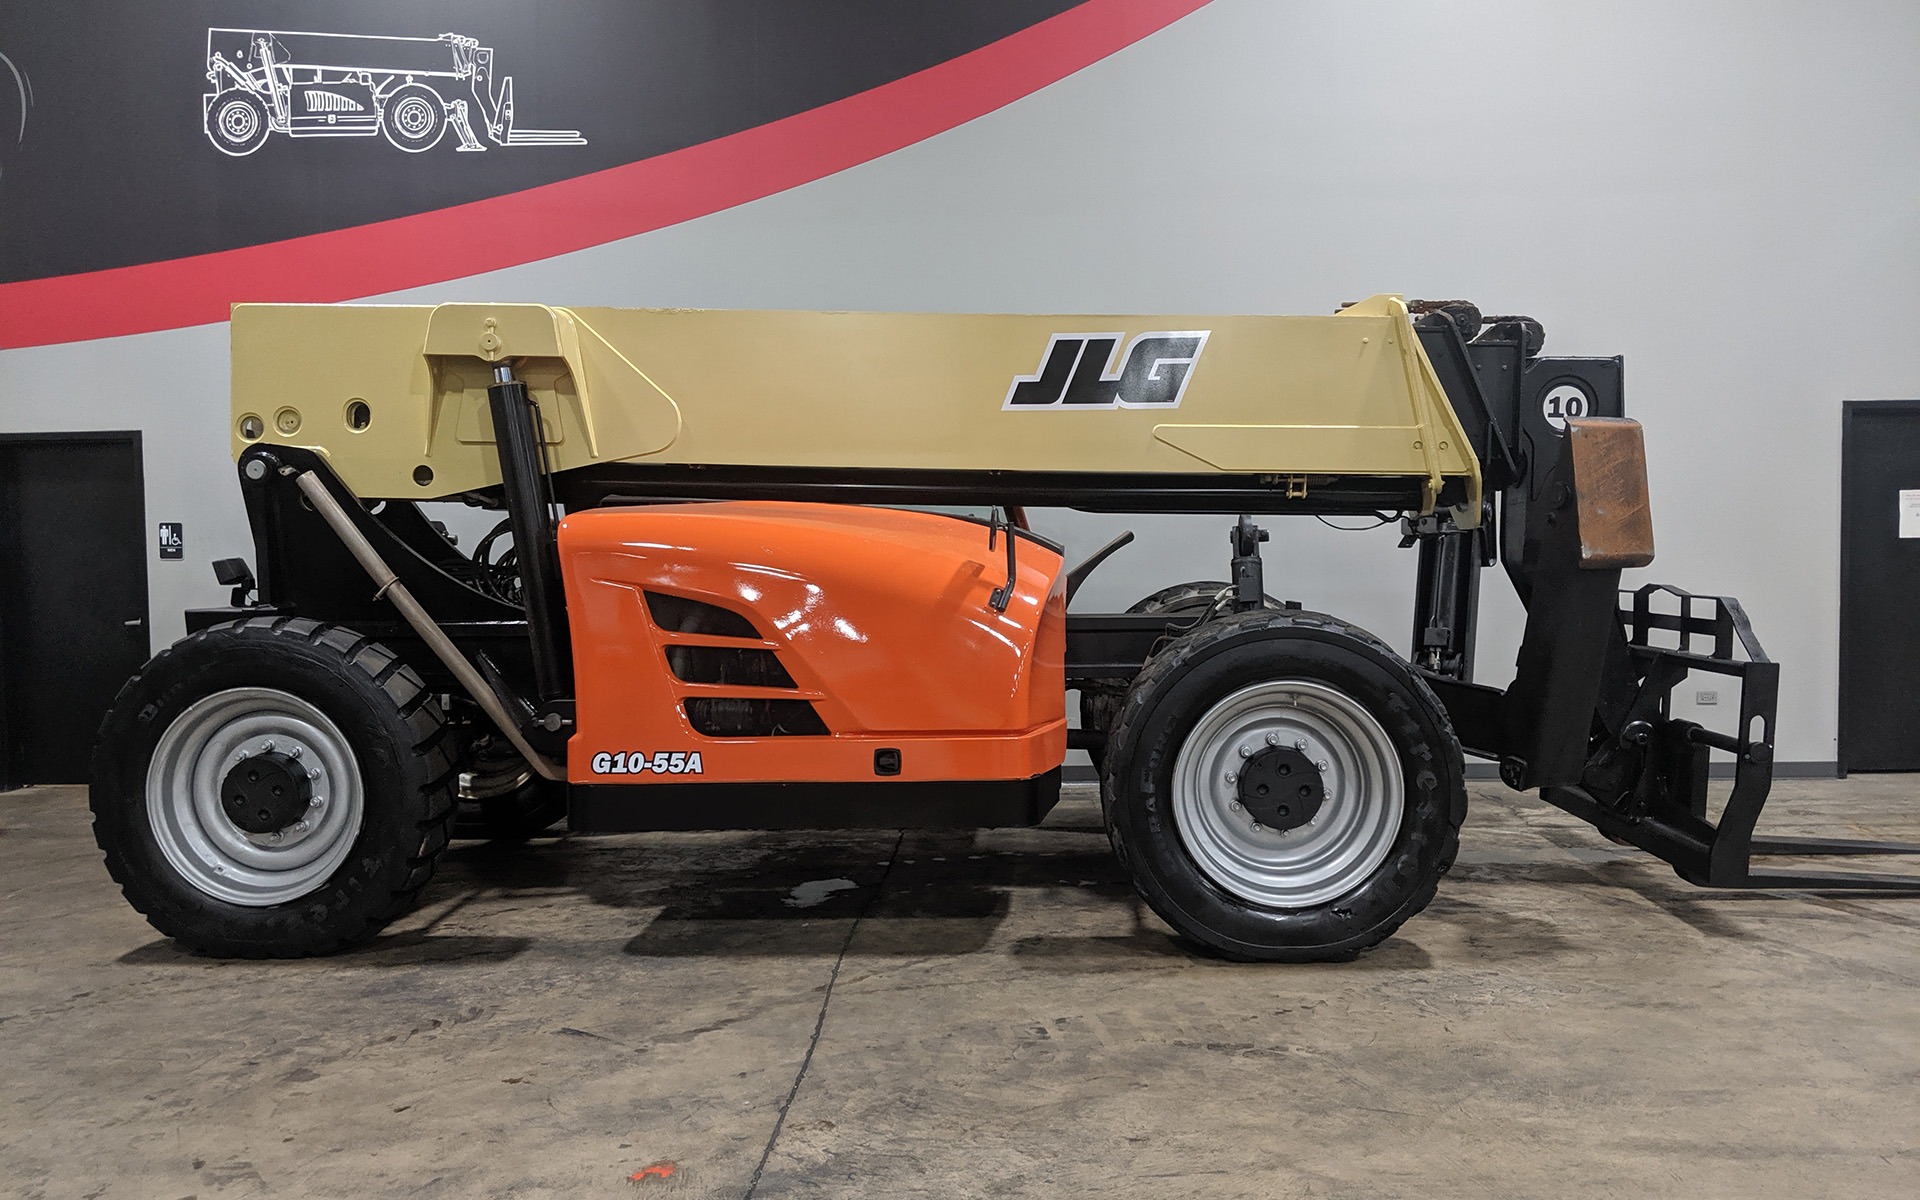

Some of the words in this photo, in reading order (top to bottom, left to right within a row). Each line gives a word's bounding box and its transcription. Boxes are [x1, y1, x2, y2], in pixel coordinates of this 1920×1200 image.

[1003, 331, 1210, 409] JLG
[1548, 396, 1583, 418] 10
[591, 751, 703, 774] G10-55A
